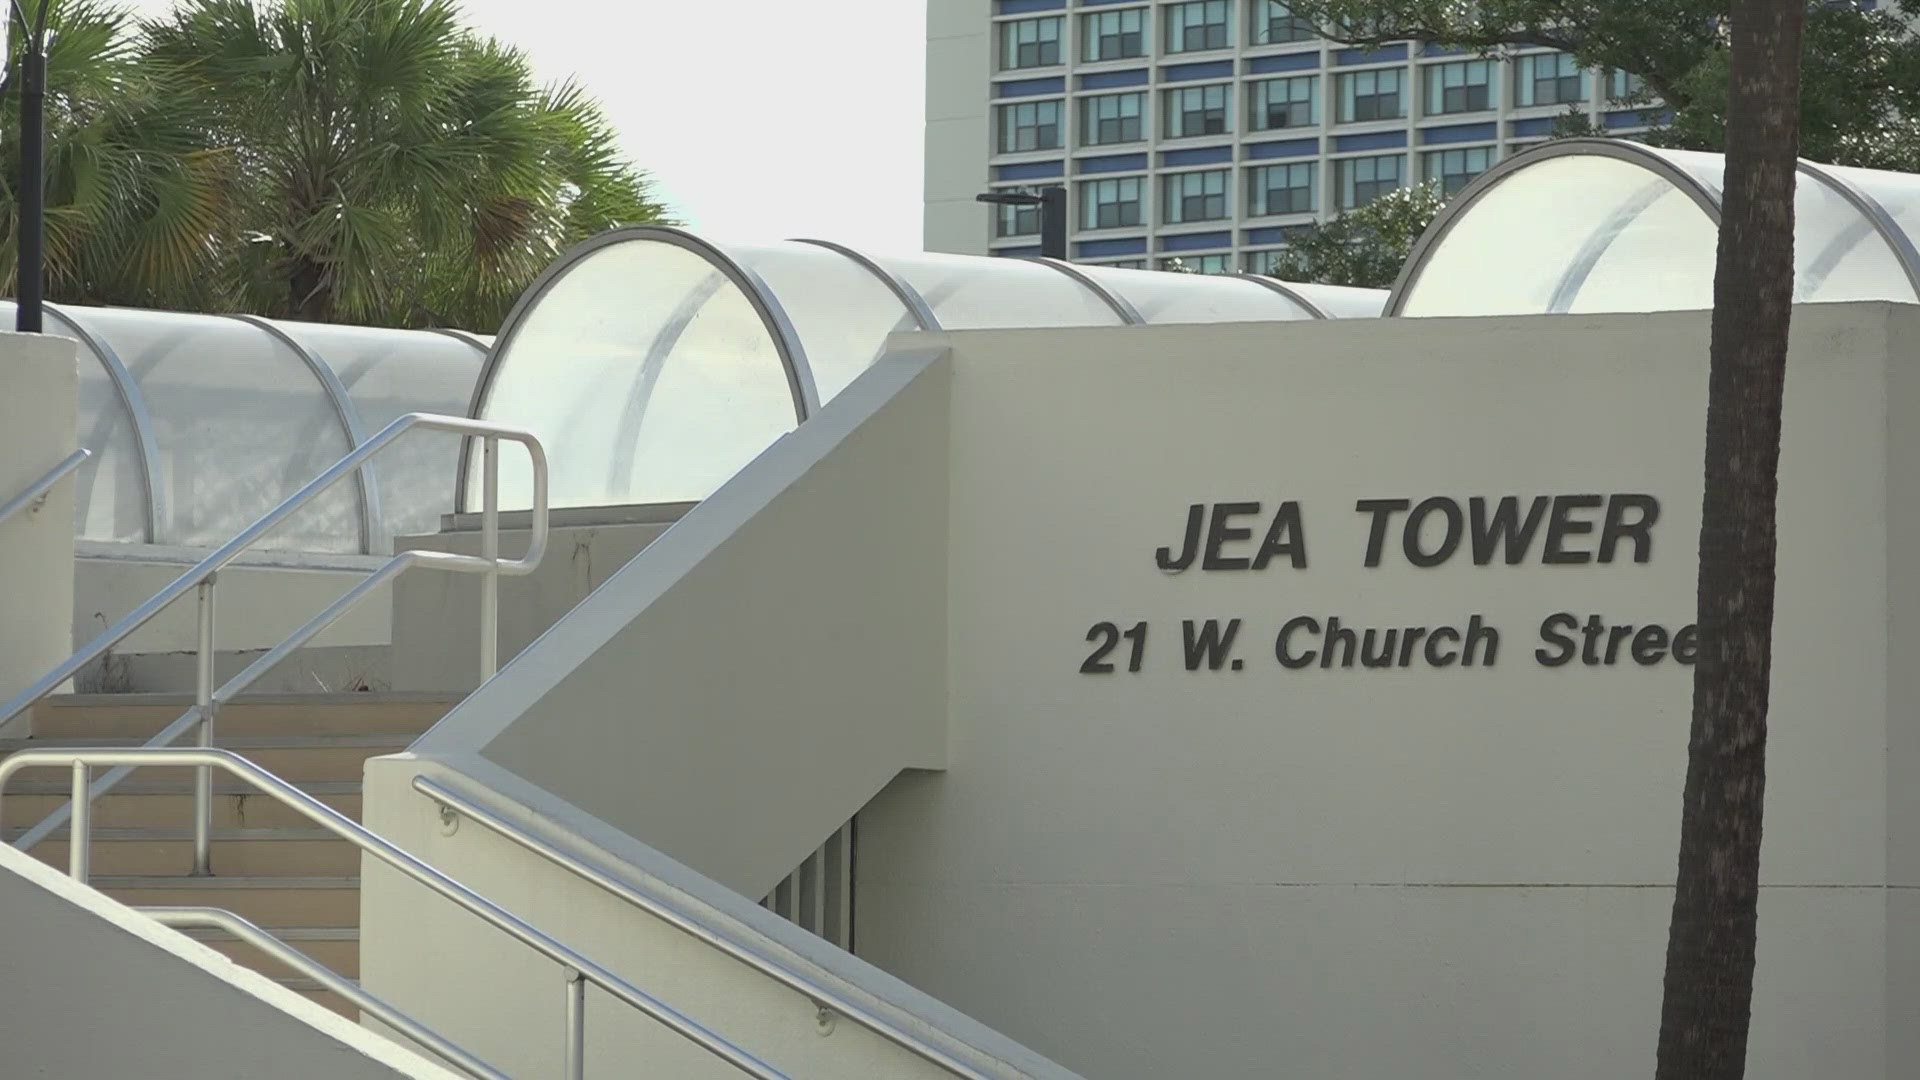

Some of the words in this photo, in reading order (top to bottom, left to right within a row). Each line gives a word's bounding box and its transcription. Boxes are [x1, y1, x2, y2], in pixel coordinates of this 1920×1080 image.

[1155, 501, 1308, 574] JEA
[1355, 494, 1661, 568] TOWER
[1079, 621, 1148, 674] 21
[1181, 618, 1244, 672] W.
[1274, 614, 1501, 671] Church
[1534, 612, 1698, 667] Stree
